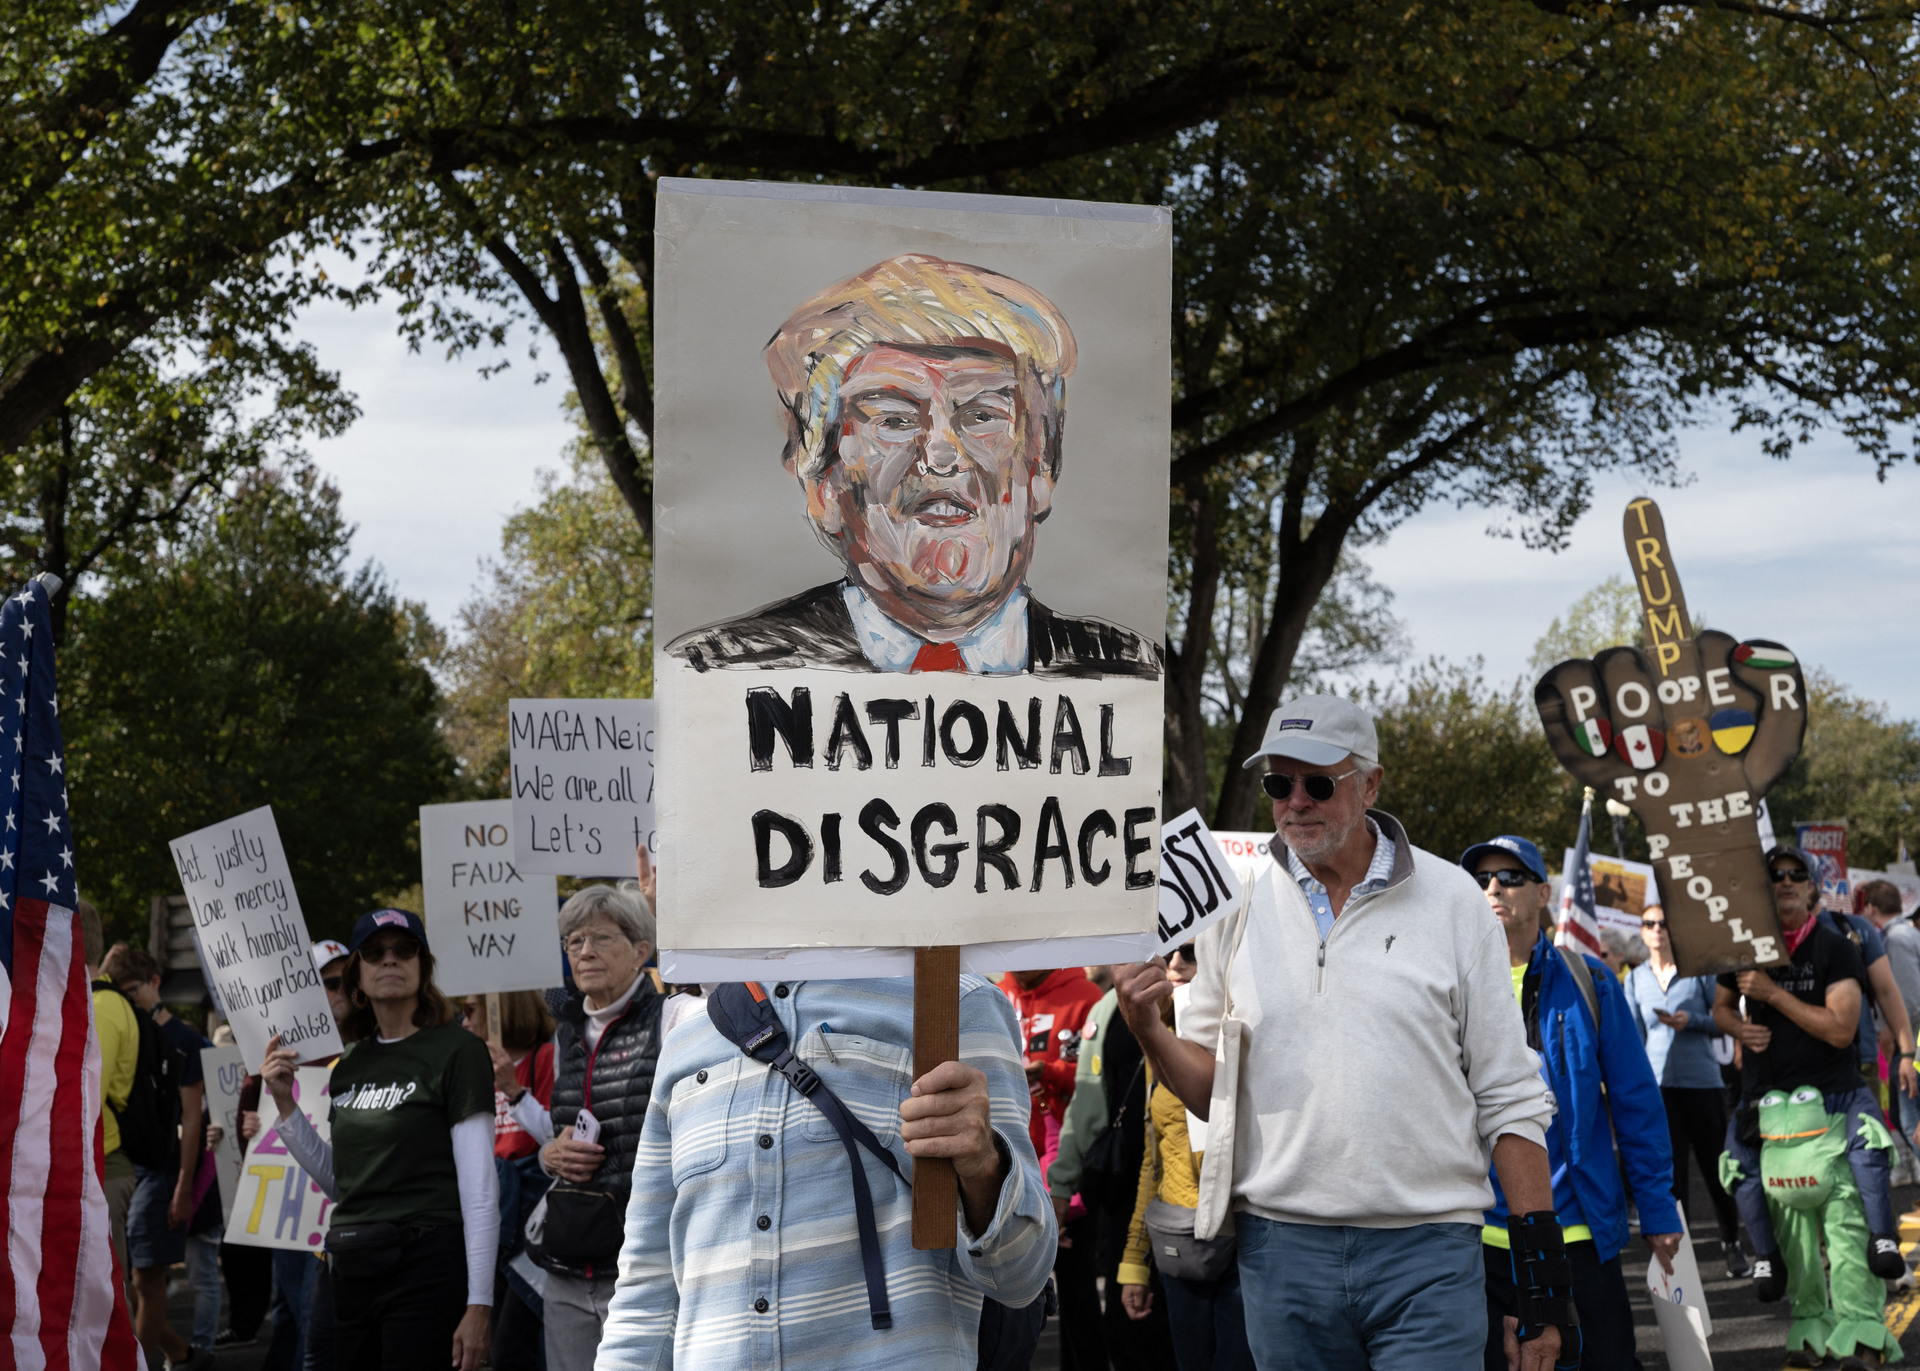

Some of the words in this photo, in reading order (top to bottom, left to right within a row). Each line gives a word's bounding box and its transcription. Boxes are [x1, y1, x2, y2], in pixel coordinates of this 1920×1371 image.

[1627, 499, 1684, 677] TRUMP
[511, 710, 589, 751] MAGA
[745, 686, 1133, 777] NATIONAL
[514, 764, 554, 802] We
[565, 775, 603, 803] are
[608, 766, 638, 804] all
[1614, 771, 1670, 802] TO
[1669, 790, 1753, 829] THE
[465, 824, 508, 848] NO
[531, 813, 602, 855] Let's
[751, 797, 1157, 895] DISGRACE
[176, 844, 207, 885] Act
[213, 829, 268, 888] justly
[452, 861, 524, 887] FAUX
[1158, 820, 1233, 943] SIST
[1645, 832, 1779, 964] PEOPLE
[193, 896, 226, 928] Love
[234, 878, 288, 912] mercy
[463, 898, 523, 926] KING
[241, 913, 303, 957] humbly
[467, 933, 516, 958] WAY
[256, 977, 284, 1018] your
[281, 951, 321, 994] God
[268, 1016, 311, 1048] Micah
[748, 1031, 773, 1051] patagonia
[352, 1080, 417, 1110] liberty?
[1769, 1175, 1818, 1188] ANTIFA
